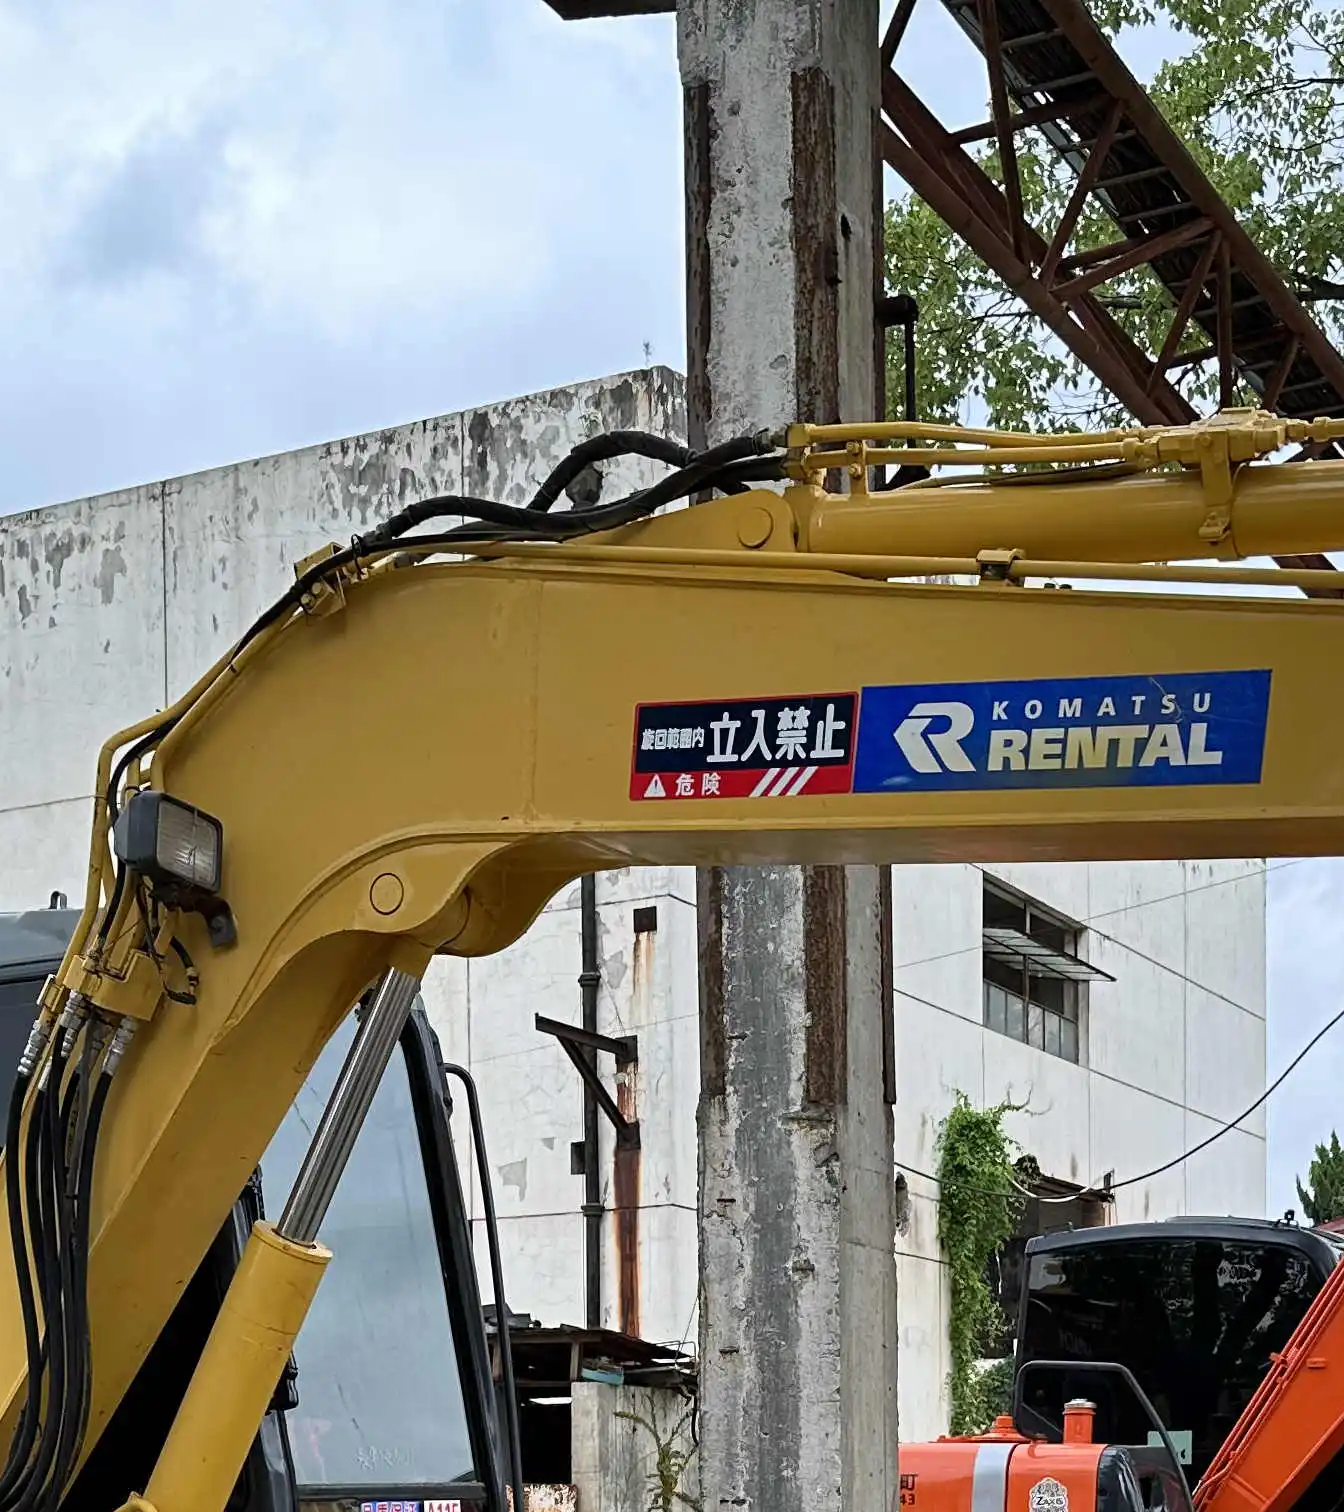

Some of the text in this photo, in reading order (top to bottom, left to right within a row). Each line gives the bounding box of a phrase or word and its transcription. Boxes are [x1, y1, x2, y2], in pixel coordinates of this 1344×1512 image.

[991, 692, 1212, 721] KOMATSU
[706, 703, 846, 763] 立入禁止
[987, 722, 1222, 772] RENTAL
[675, 773, 721, 796] 危険
